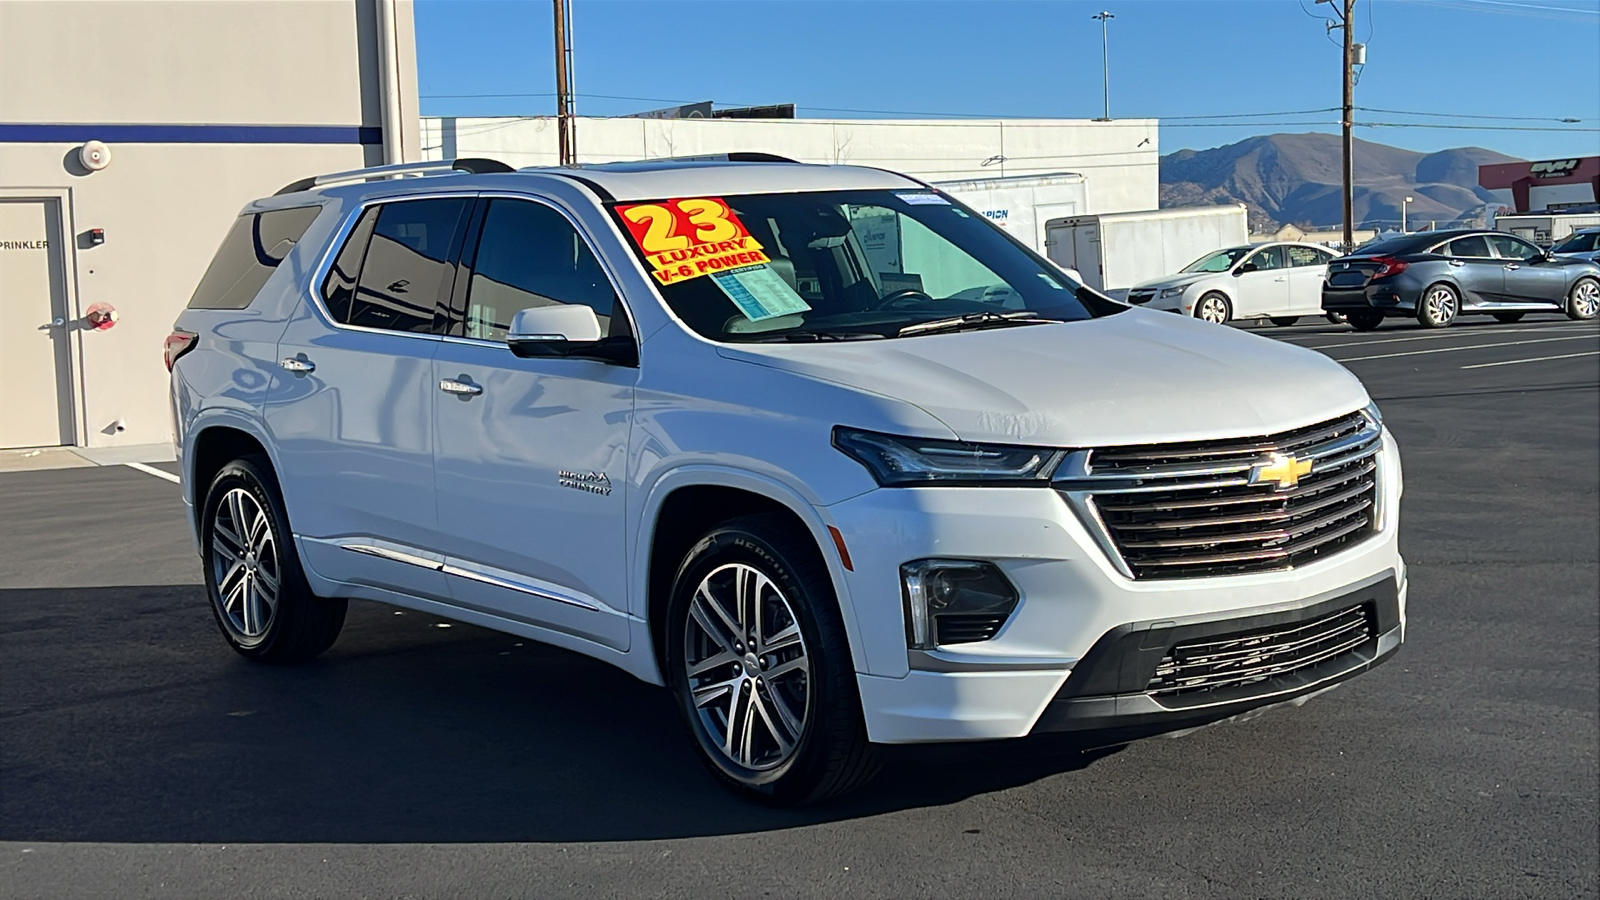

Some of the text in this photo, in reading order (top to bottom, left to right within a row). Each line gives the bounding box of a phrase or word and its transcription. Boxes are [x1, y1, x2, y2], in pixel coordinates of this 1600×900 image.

[624, 199, 741, 252] 23
[982, 209, 1008, 220] PION
[657, 238, 747, 265] LUXURY
[656, 250, 767, 282] V-6 POWER
[559, 479, 612, 496] COUNTRY
